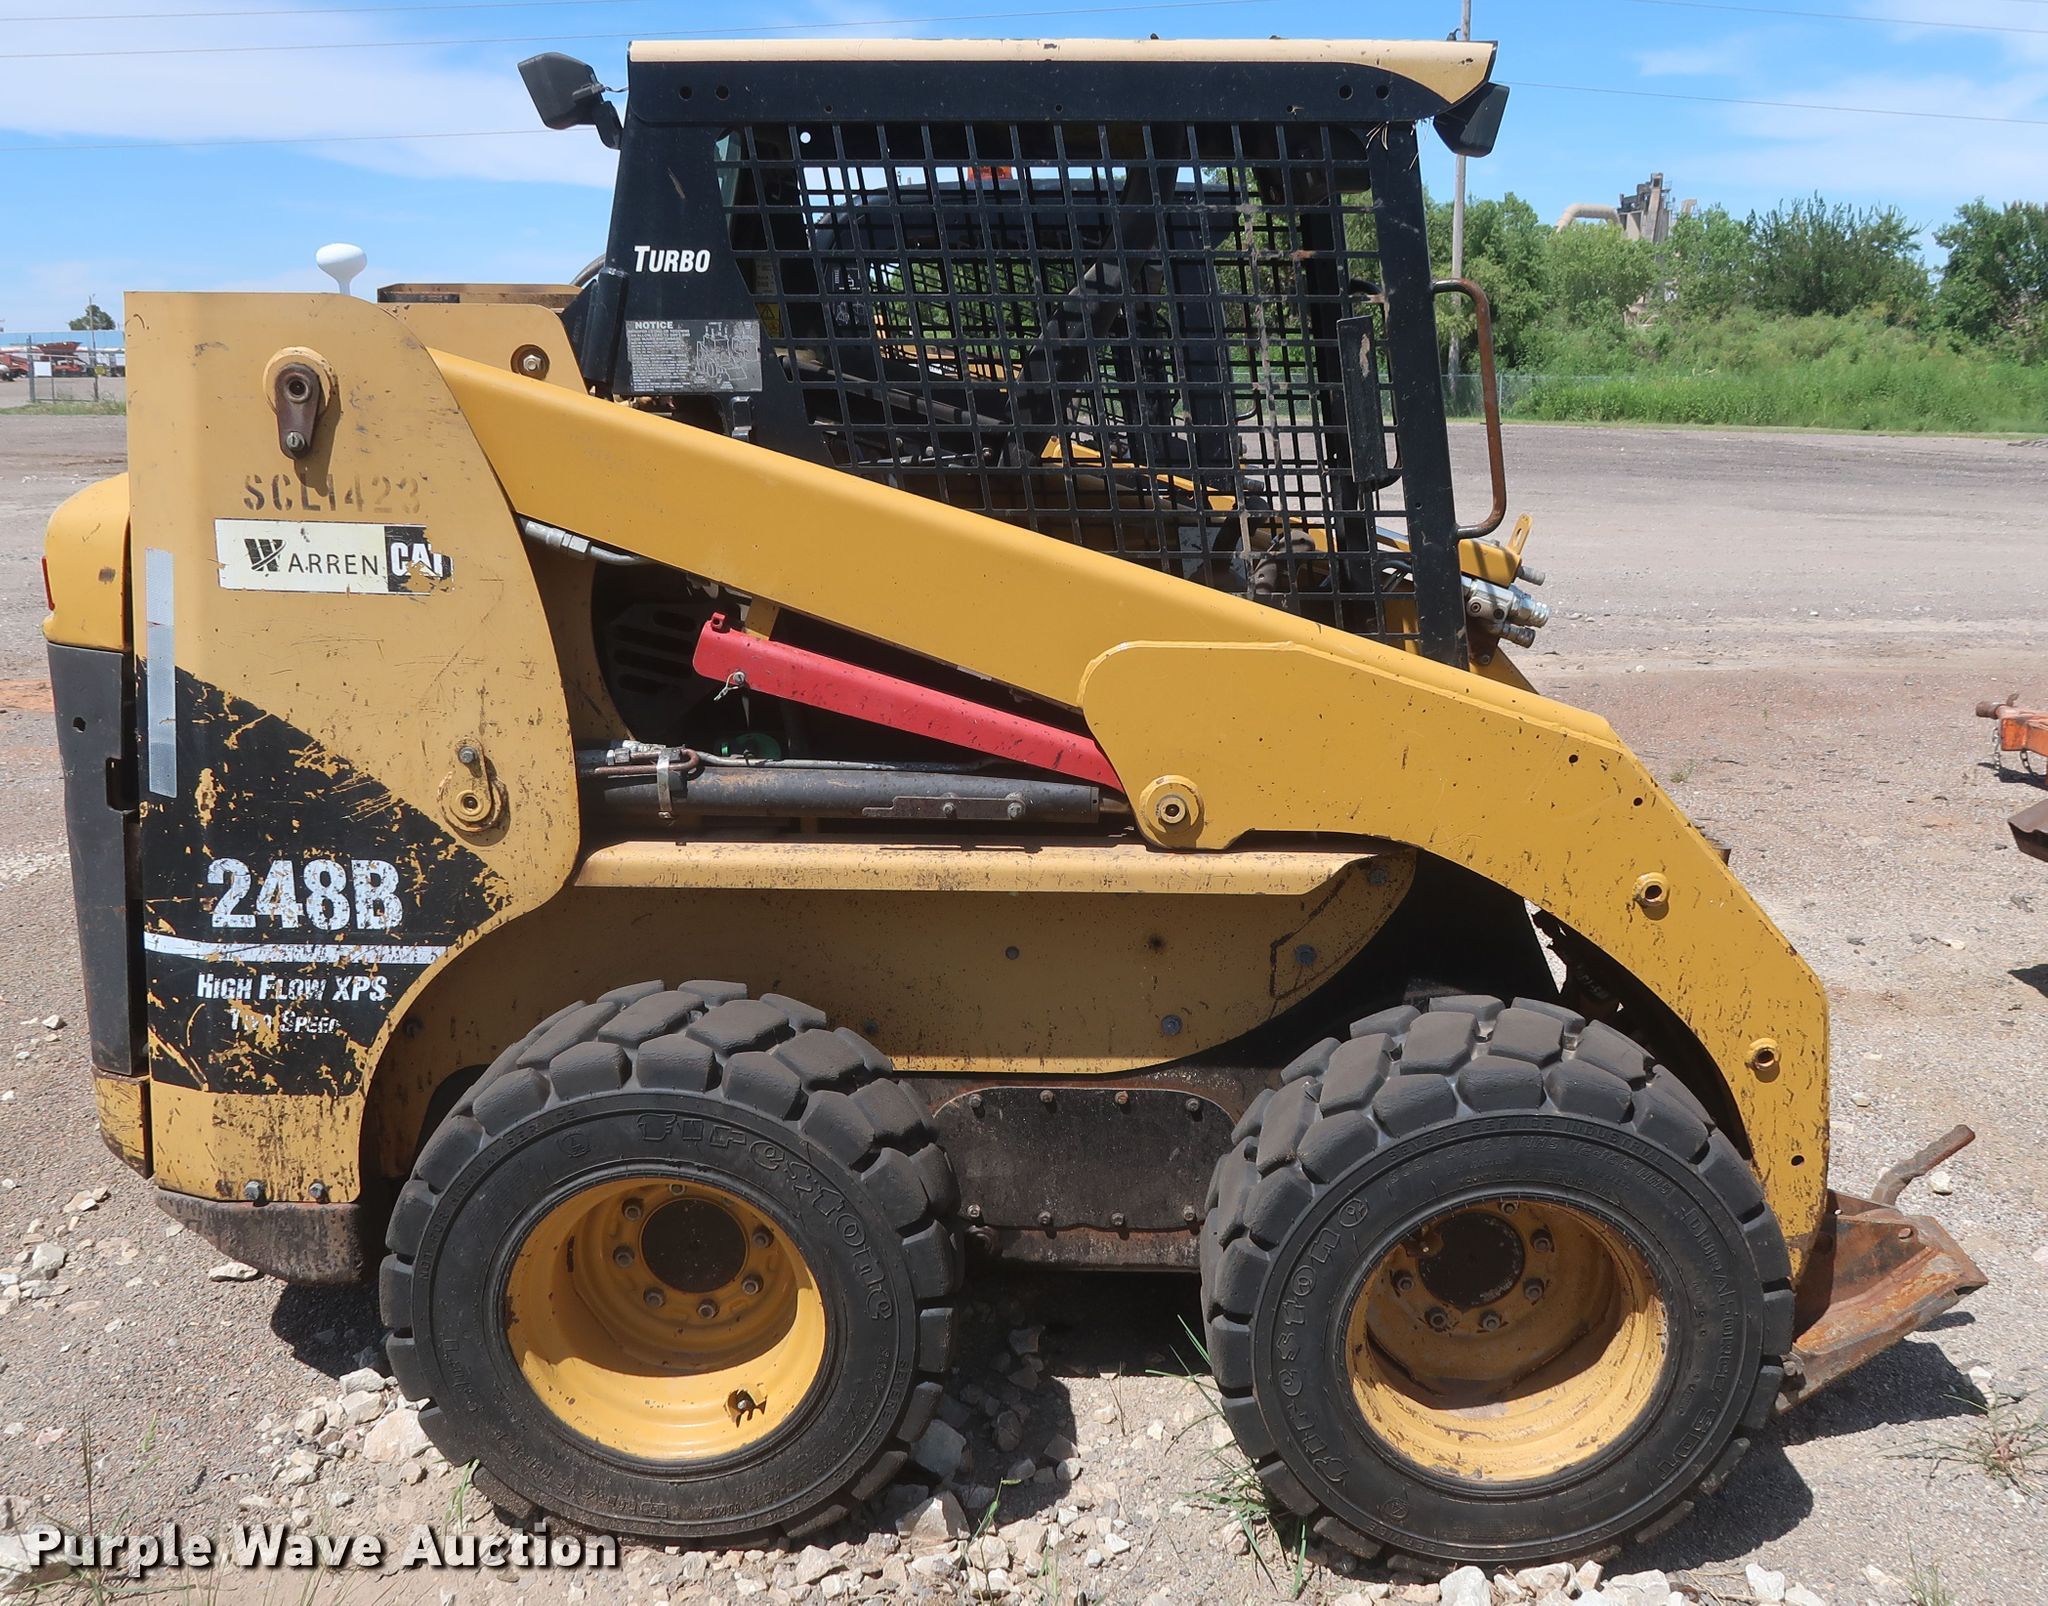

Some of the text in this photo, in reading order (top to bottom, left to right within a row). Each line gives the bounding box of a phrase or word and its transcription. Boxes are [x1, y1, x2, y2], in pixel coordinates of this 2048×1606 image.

[634, 245, 711, 273] TURBO
[634, 321, 674, 330] NOTICE
[244, 538, 379, 576] WARREN
[206, 857, 403, 931] 248B
[197, 973, 388, 1002] HIGH FLOW XPS
